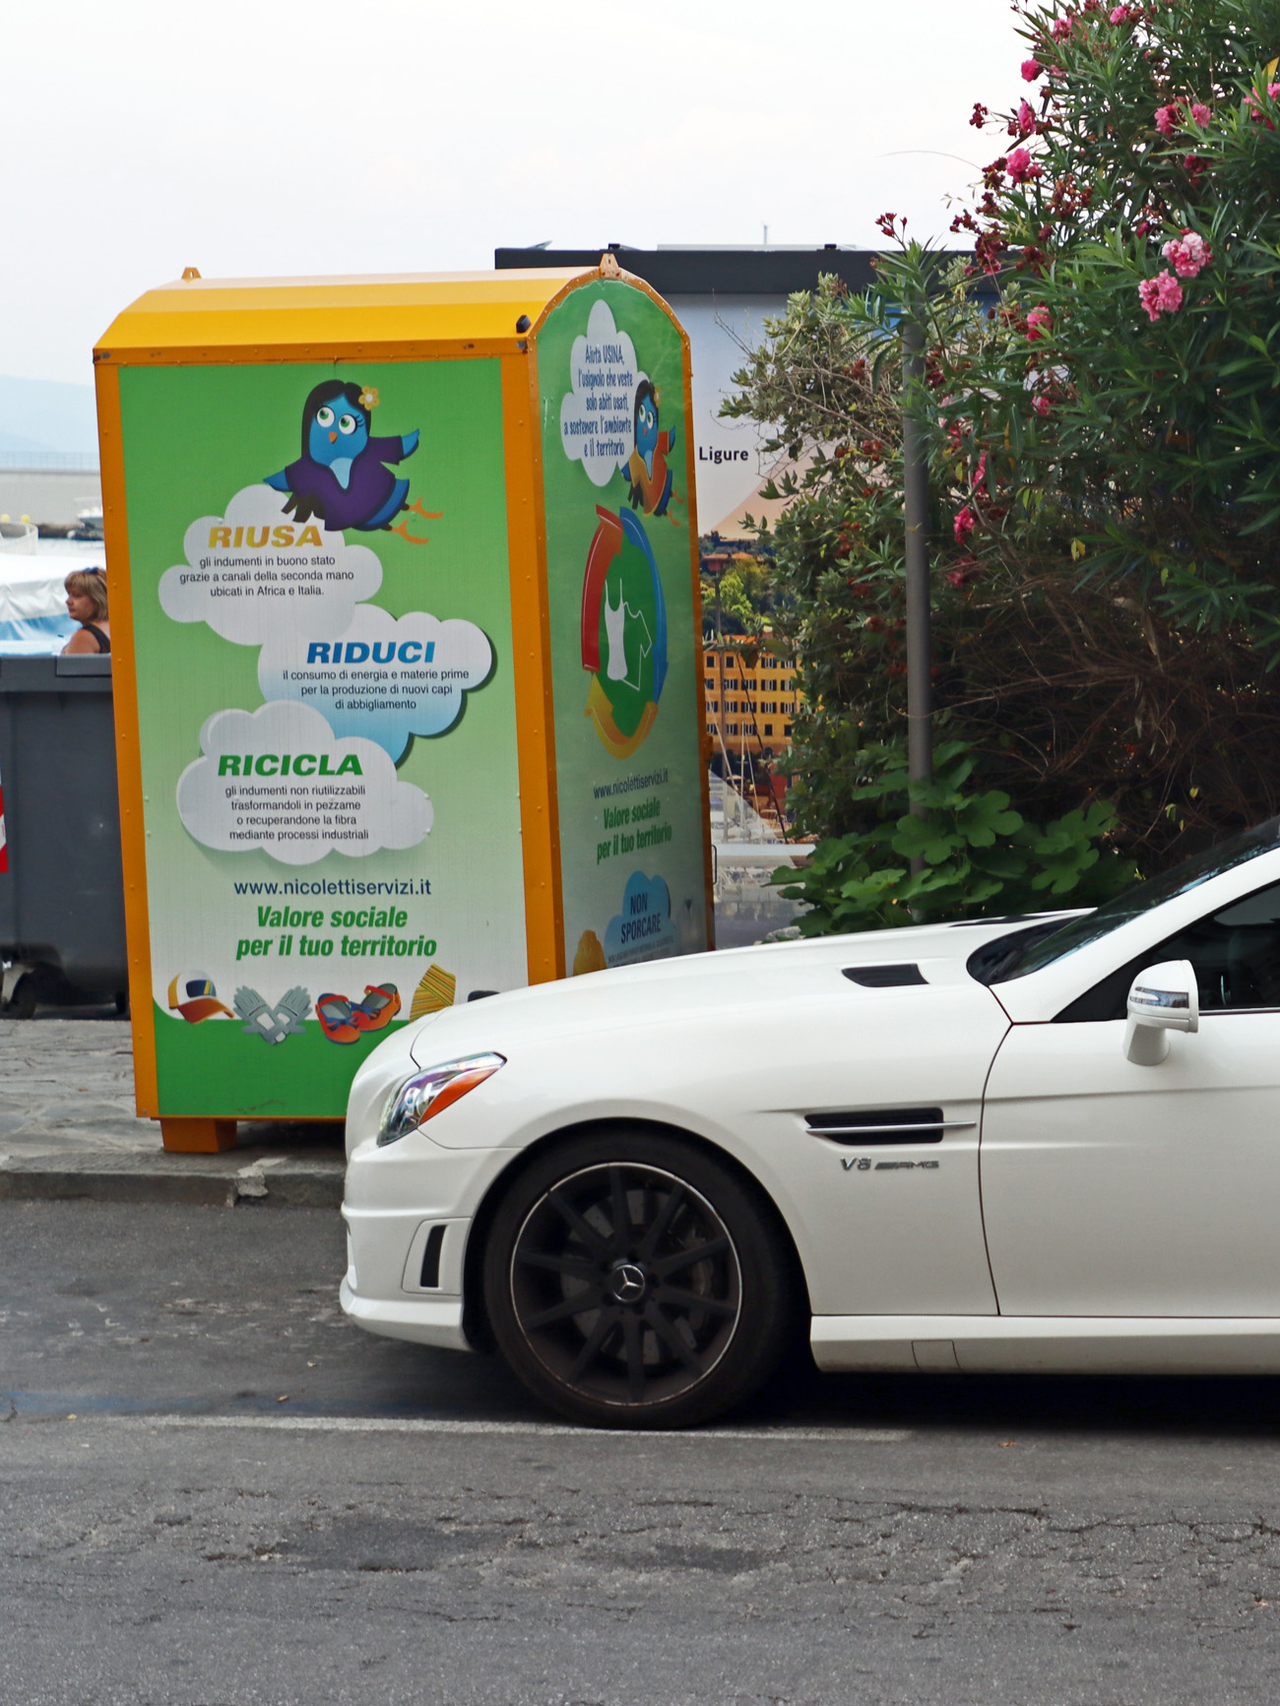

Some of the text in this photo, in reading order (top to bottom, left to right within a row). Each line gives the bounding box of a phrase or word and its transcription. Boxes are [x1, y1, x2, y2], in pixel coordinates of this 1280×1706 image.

[586, 345, 601, 363] Aiuta
[578, 368, 633, 390] l'usignolo che veste
[586, 392, 629, 411] solo abiti usati,
[564, 415, 631, 435] a sostenere l'ambiente
[584, 438, 624, 457] e il territorio
[699, 446, 748, 464] Ligure
[208, 526, 322, 548] RIUSA
[200, 556, 335, 568] gli indumenti in buono stato
[180, 572, 209, 584] grazie
[222, 572, 251, 581] canali
[254, 572, 278, 581] della
[281, 571, 323, 581] seconda
[326, 572, 354, 580] mano
[211, 586, 324, 597] ubicati in Africa e Italia.
[307, 641, 435, 664] RIDUCI
[283, 669, 469, 682] il consumo di energia e materie prime
[301, 684, 452, 697] per la produzione di nuovi capi
[335, 699, 416, 711] di abbigliamento
[218, 754, 363, 776] RICICLA
[225, 785, 365, 798] gli indumenti non riutilizzabili
[593, 769, 668, 799] www.nicolettiservizi.it
[231, 800, 361, 812] trasformandoli in pezzame
[604, 797, 660, 829] Valore sociale
[237, 815, 356, 827] o recuperandone la fibra
[230, 829, 369, 841] mediante processi industriali
[597, 822, 672, 865] per il tuo territorio
[234, 878, 431, 895] www.nicolettiservizi.it
[630, 892, 648, 915] NON
[257, 905, 408, 928] Valore sociale
[621, 913, 661, 944] SPORCARE
[236, 934, 437, 961] per il tuo territorio
[840, 1157, 871, 1170] V8
